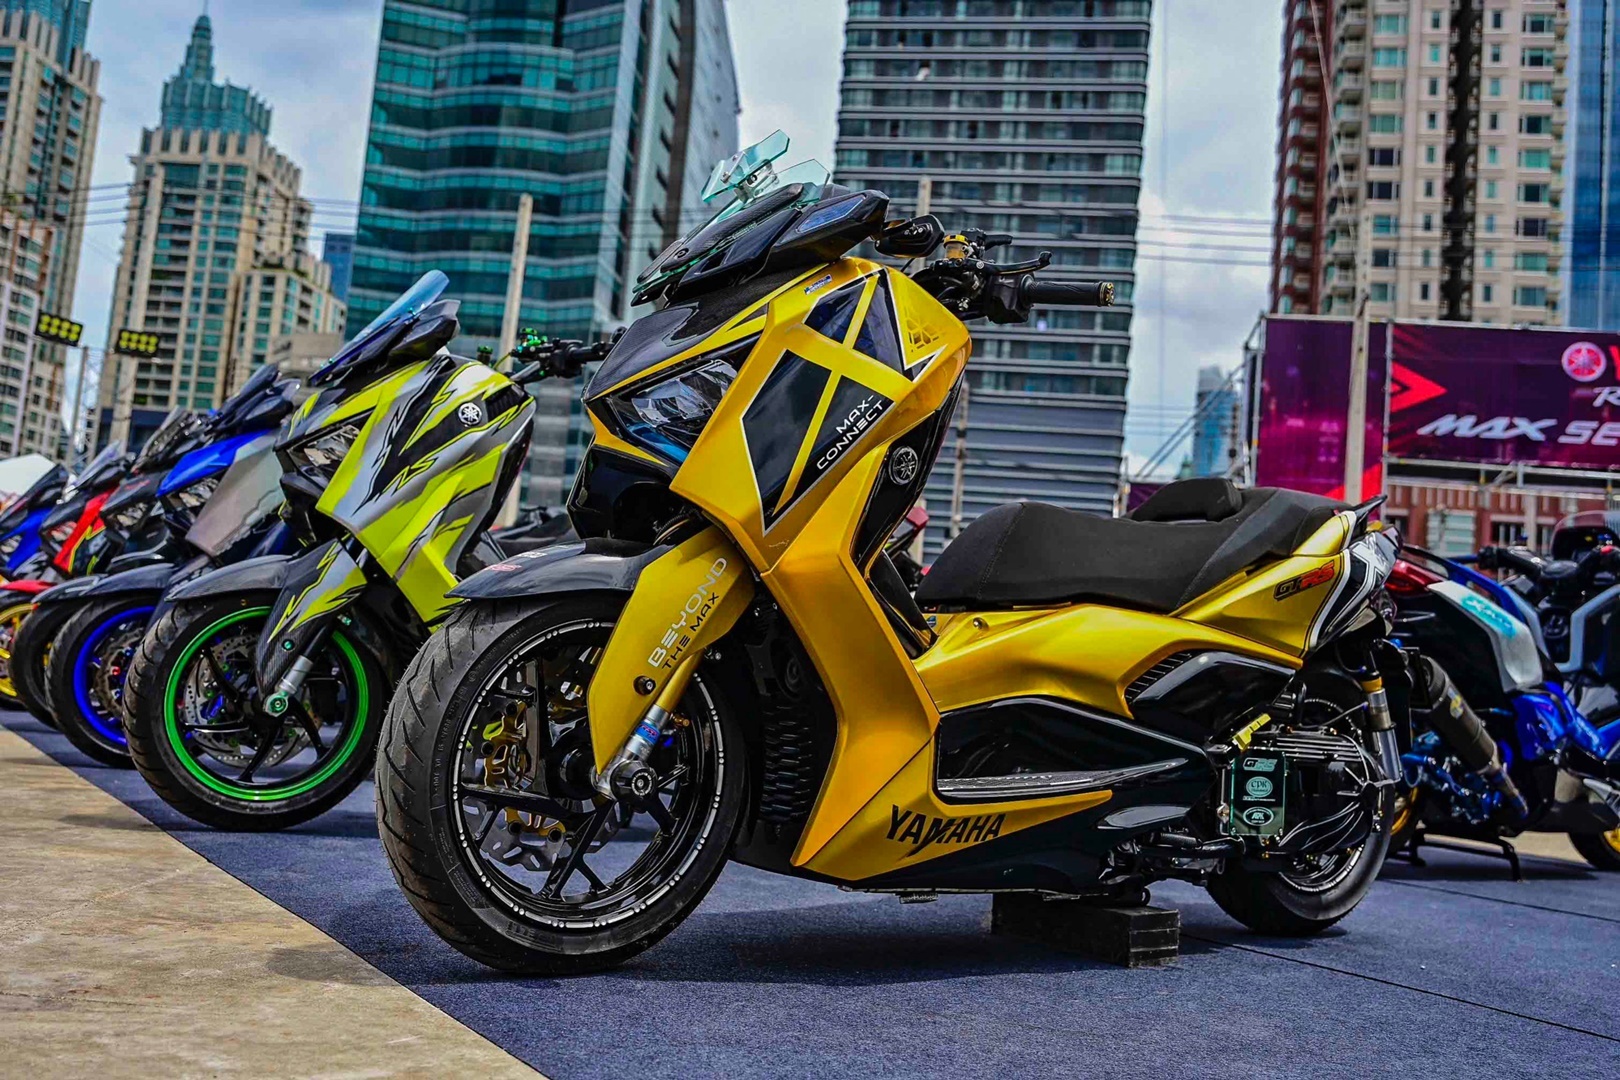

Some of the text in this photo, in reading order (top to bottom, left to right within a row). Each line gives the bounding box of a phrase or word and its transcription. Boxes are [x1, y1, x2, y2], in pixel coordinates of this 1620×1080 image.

[816, 400, 883, 469] CONNECT
[1416, 414, 1558, 441] MAX
[647, 557, 727, 668] BEYOND
[661, 592, 720, 669] THE MAX
[886, 804, 1006, 857] YAMAHA
